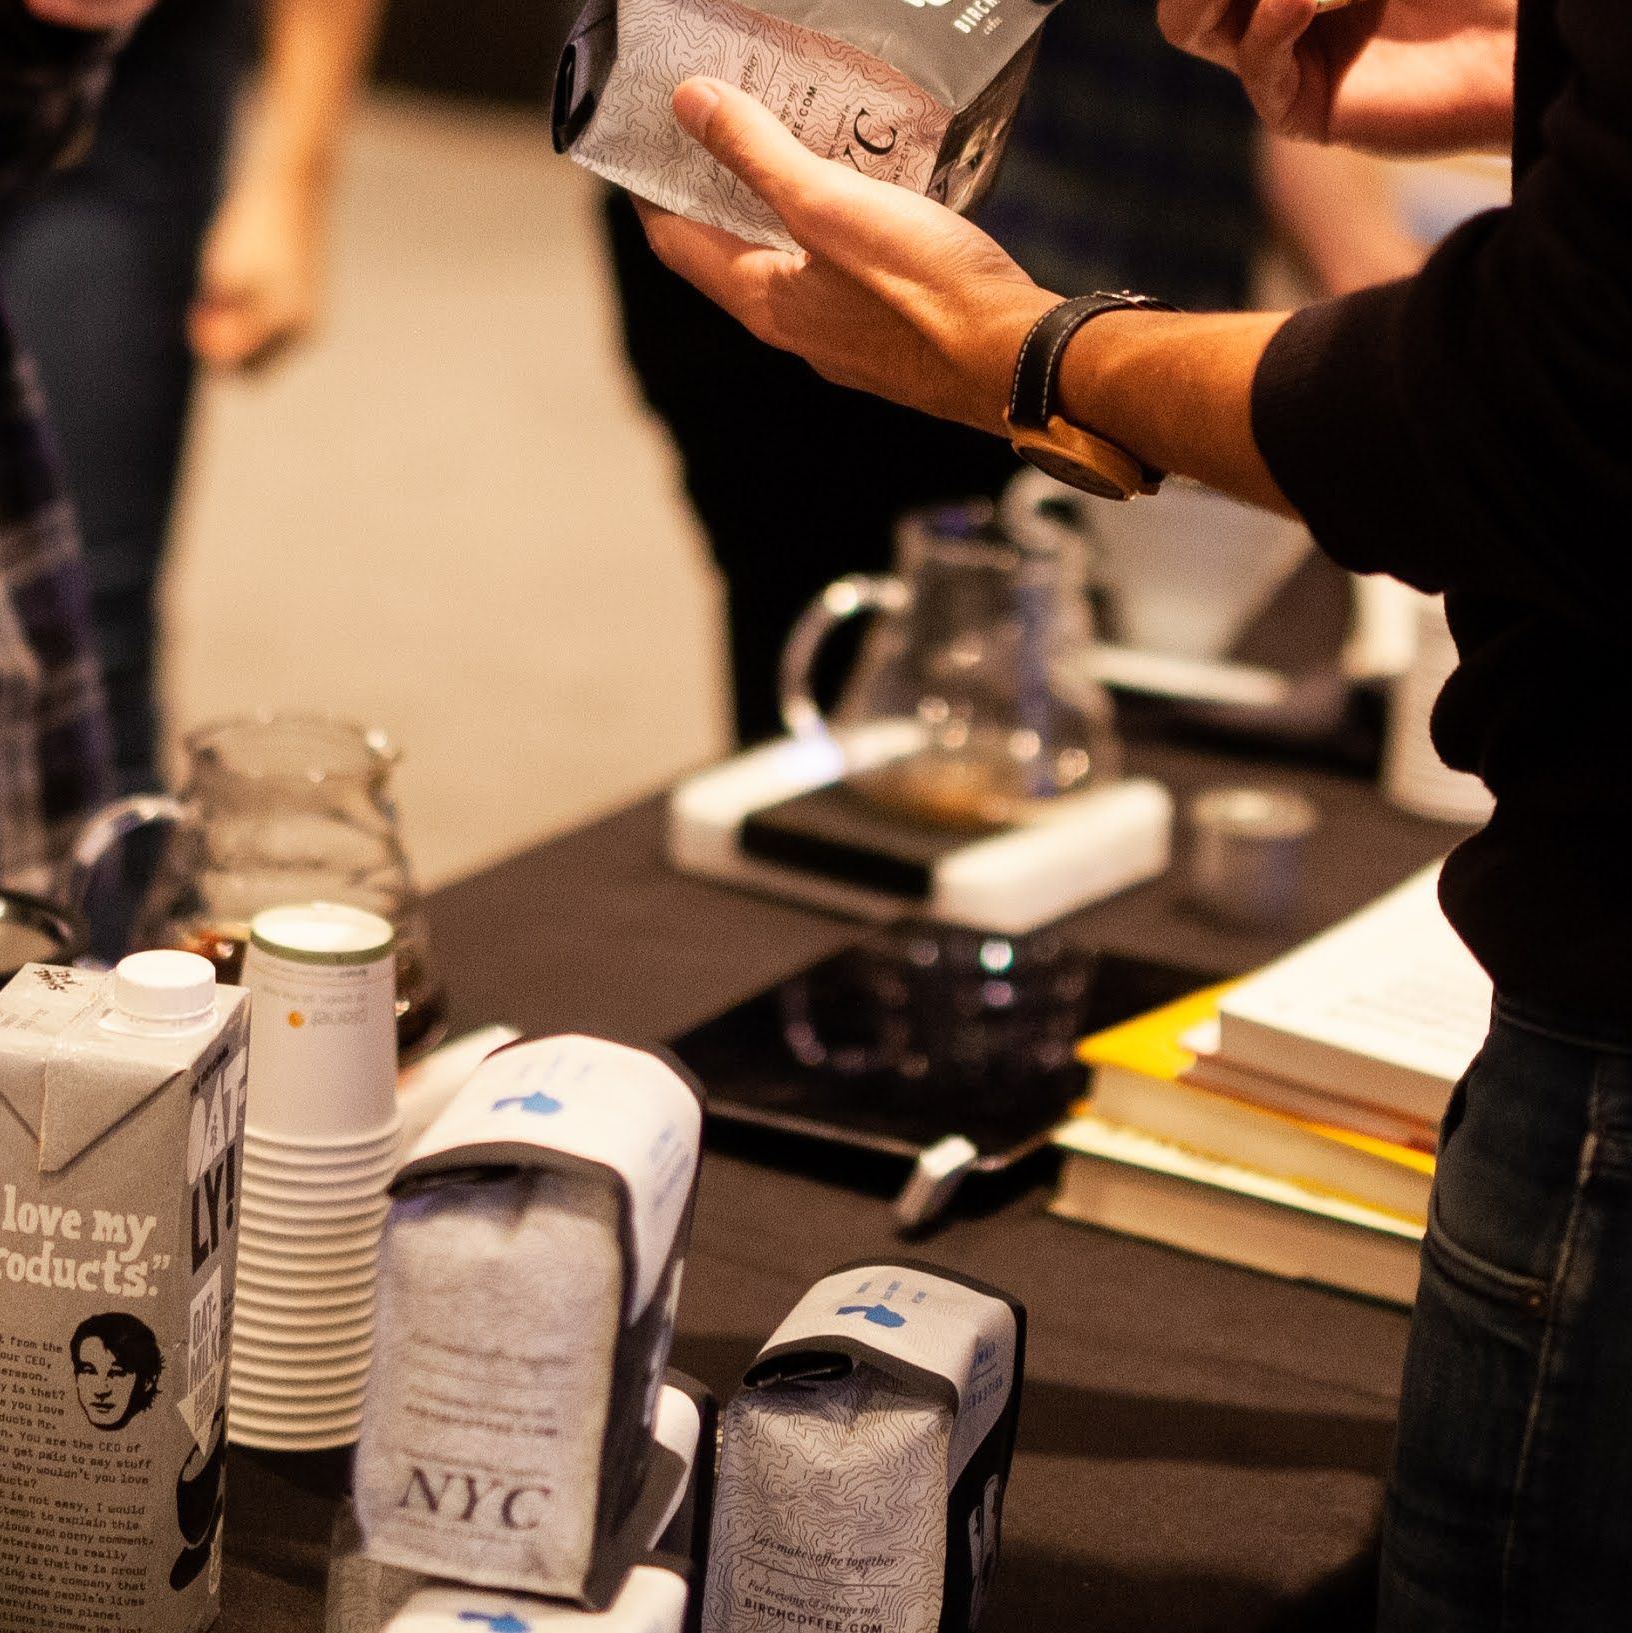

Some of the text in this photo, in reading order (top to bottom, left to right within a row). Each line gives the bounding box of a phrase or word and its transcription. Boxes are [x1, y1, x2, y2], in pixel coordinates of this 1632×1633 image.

[2, 1184, 82, 1240] love
[92, 1210, 157, 1262] my
[10, 1336, 37, 1349] from
[42, 1342, 63, 1354] the
[0, 1352, 20, 1362] our
[25, 1354, 52, 1370] CEO,
[12, 1383, 25, 1395] is
[31, 1387, 65, 1401] that?
[12, 1401, 32, 1411] you
[37, 1403, 65, 1417] love
[37, 1419, 56, 1430] Mr.
[19, 1431, 40, 1443] You
[45, 1436, 67, 1447] are
[72, 1439, 94, 1451] the
[98, 1441, 121, 1453] CEO
[126, 1443, 141, 1453] of
[13, 1448, 33, 1458] get
[38, 1451, 66, 1463] paid
[71, 1454, 85, 1465] to
[90, 1458, 111, 1469] say
[116, 1458, 153, 1469] stuff
[95, 1473, 116, 1484] you
[121, 1473, 149, 1485] love
[11, 1491, 23, 1502] is
[28, 1495, 49, 1506] not
[54, 1499, 88, 1514] easy,
[108, 1504, 146, 1516] would
[398, 1465, 551, 1530] NYC
[41, 1511, 54, 1521] to
[58, 1515, 107, 1528] explain
[112, 1519, 139, 1530] this
[35, 1527, 55, 1538] and
[59, 1531, 94, 1544] corny
[98, 1535, 154, 1546] comment.
[64, 1545, 78, 1556] is
[84, 1548, 128, 1563] really
[776, 1542, 807, 1558] make
[1, 1552, 20, 1564] say
[25, 1555, 38, 1565] is
[43, 1557, 69, 1569] that
[74, 1561, 88, 1572] he
[93, 1563, 106, 1574] is
[111, 1566, 147, 1577] proud
[30, 1571, 44, 1582] at
[61, 1577, 111, 1592] company
[117, 1581, 147, 1592] that
[5, 1583, 50, 1598] upgrade
[54, 1590, 105, 1604] people's
[110, 1595, 146, 1607] lives
[748, 1578, 764, 1593] For
[765, 1586, 805, 1608] brewing
[821, 1601, 858, 1618] storage
[40, 1617, 54, 1627] to
[53, 1604, 73, 1615] the
[78, 1608, 121, 1621] planet
